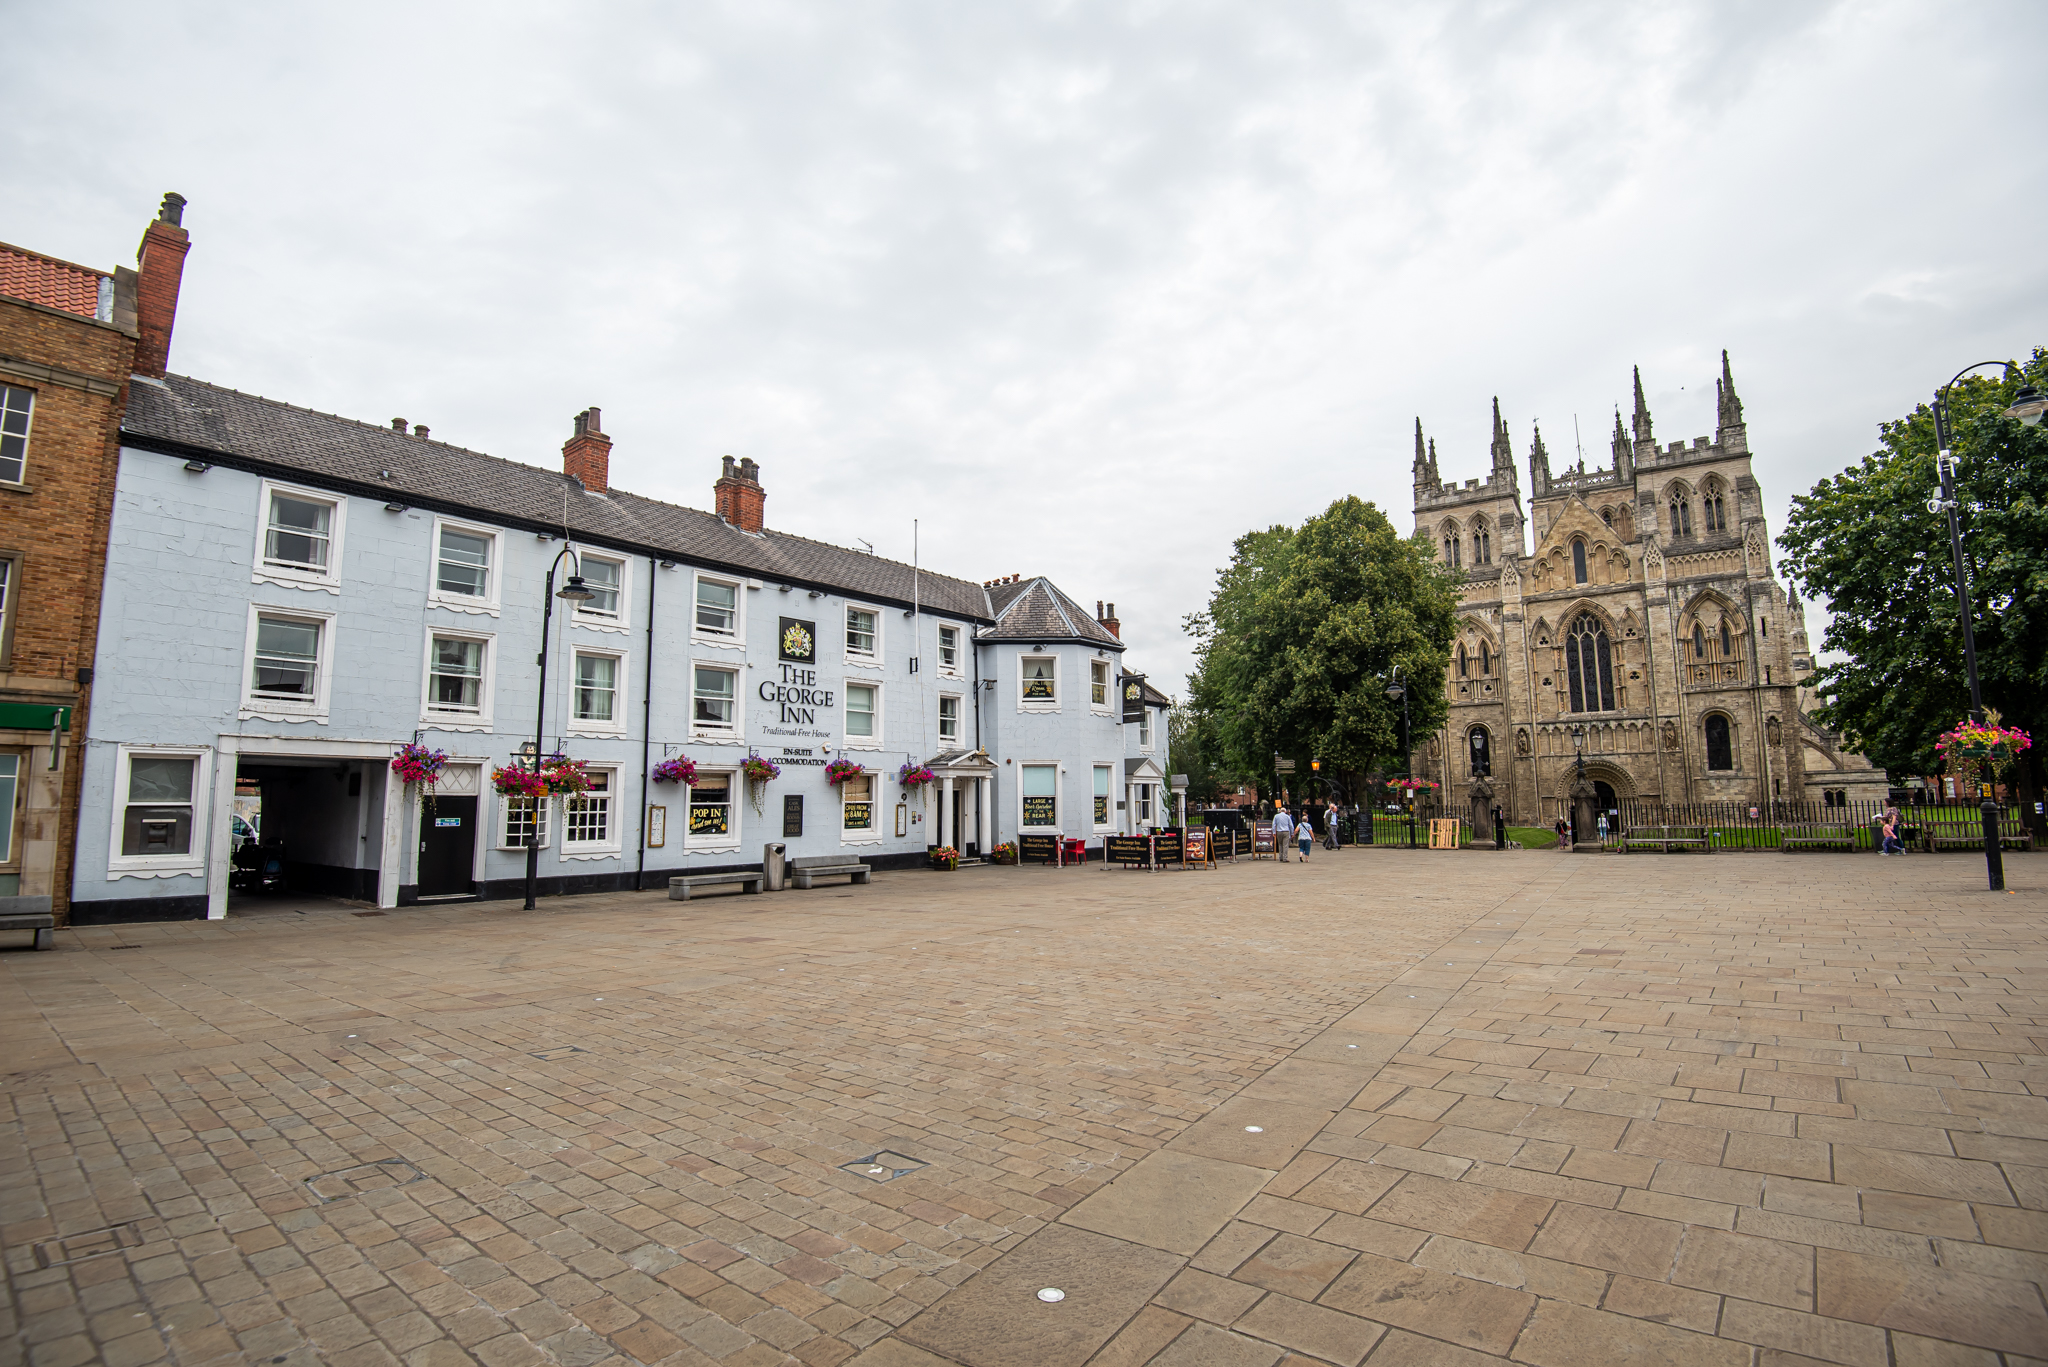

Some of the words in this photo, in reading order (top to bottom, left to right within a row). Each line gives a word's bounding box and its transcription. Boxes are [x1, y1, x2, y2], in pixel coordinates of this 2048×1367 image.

[778, 663, 816, 686] THE
[759, 681, 834, 707] GEORGE
[780, 703, 815, 724] INN
[762, 726, 796, 736] Traditional
[798, 728, 811, 736] Free
[812, 729, 830, 738] House
[693, 808, 709, 817] POP
[711, 808, 721, 817] IN
